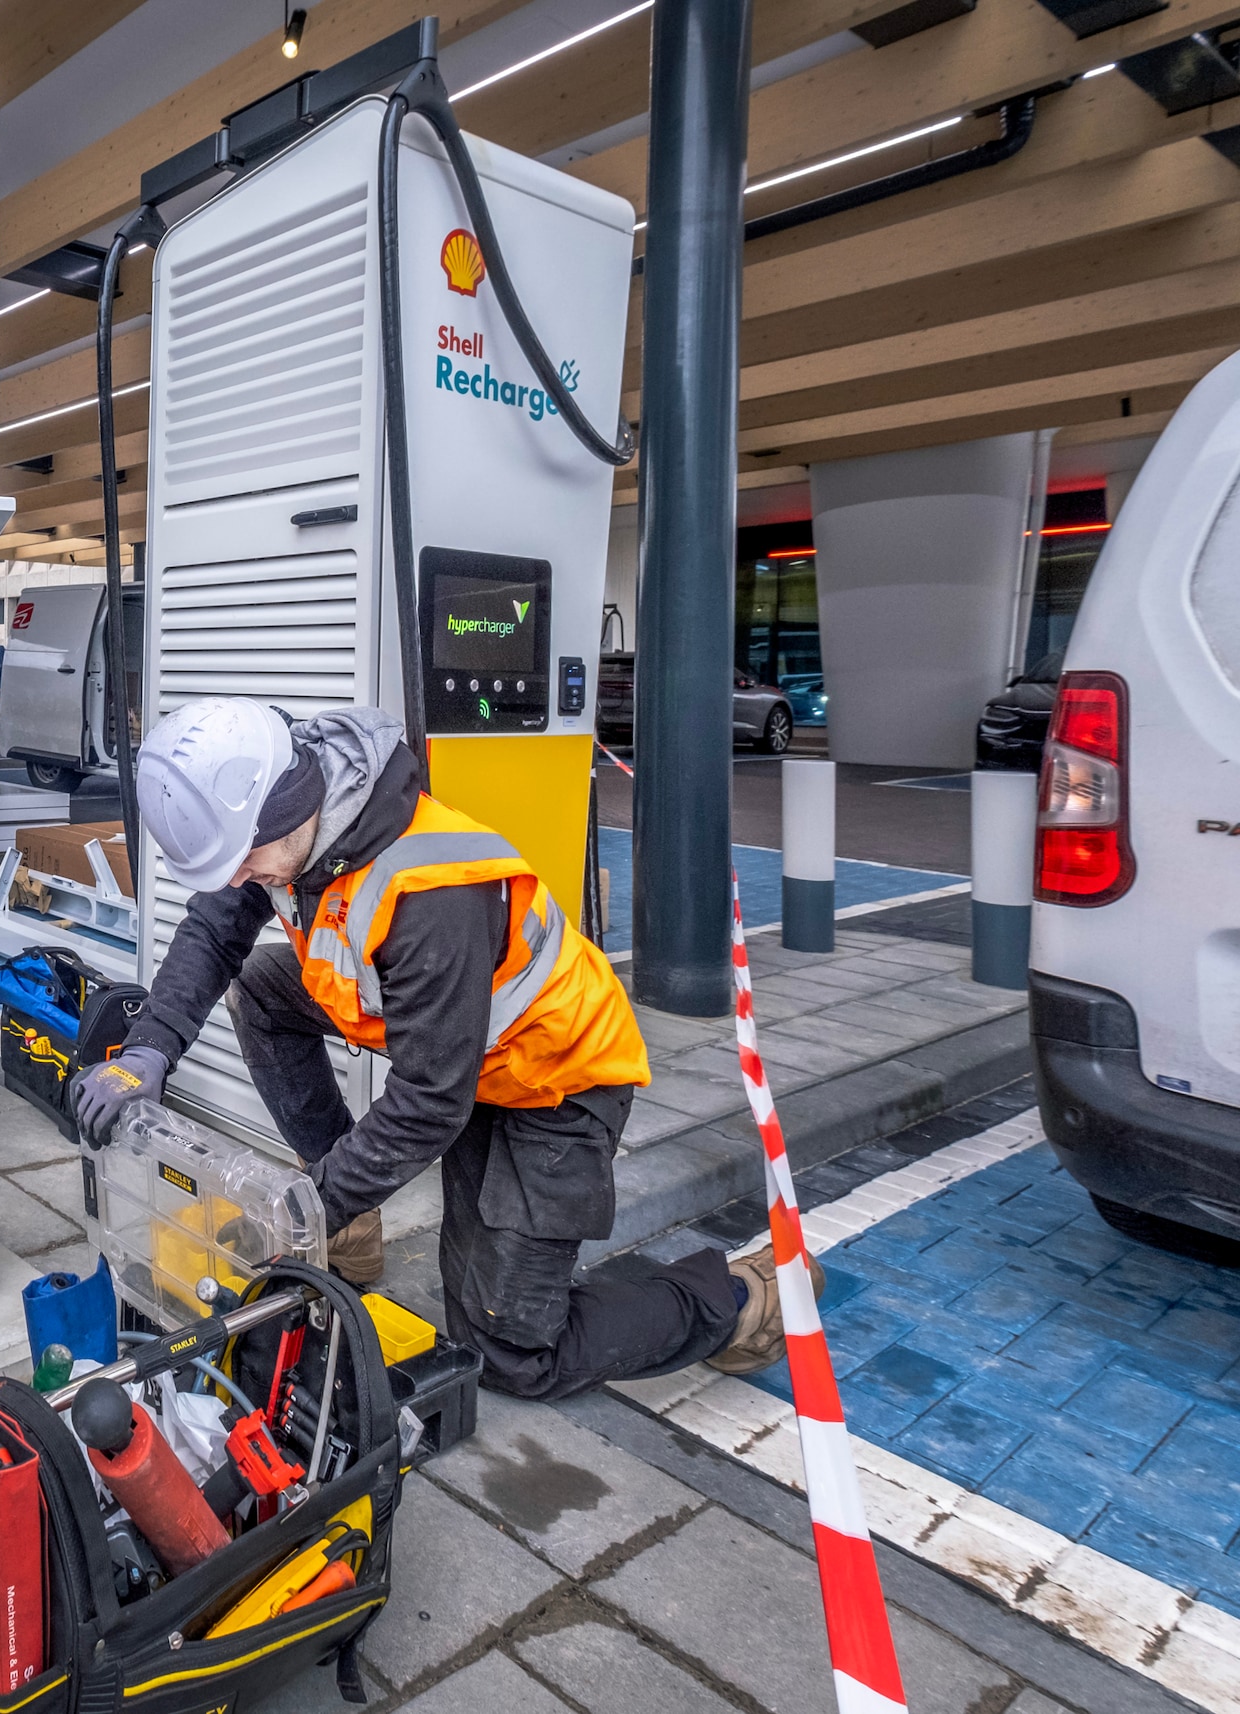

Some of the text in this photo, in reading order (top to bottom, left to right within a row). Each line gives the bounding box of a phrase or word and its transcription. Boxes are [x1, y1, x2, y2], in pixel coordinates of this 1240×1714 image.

[437, 325, 483, 359] Shell
[447, 614, 515, 638] hypercharger
[112, 1066, 139, 1084] STANLEY
[164, 1166, 192, 1186] STANLEY
[170, 1335, 197, 1354] STANLEY
[7, 1585, 17, 1656] Mechanical
[10, 1658, 18, 1668] &
